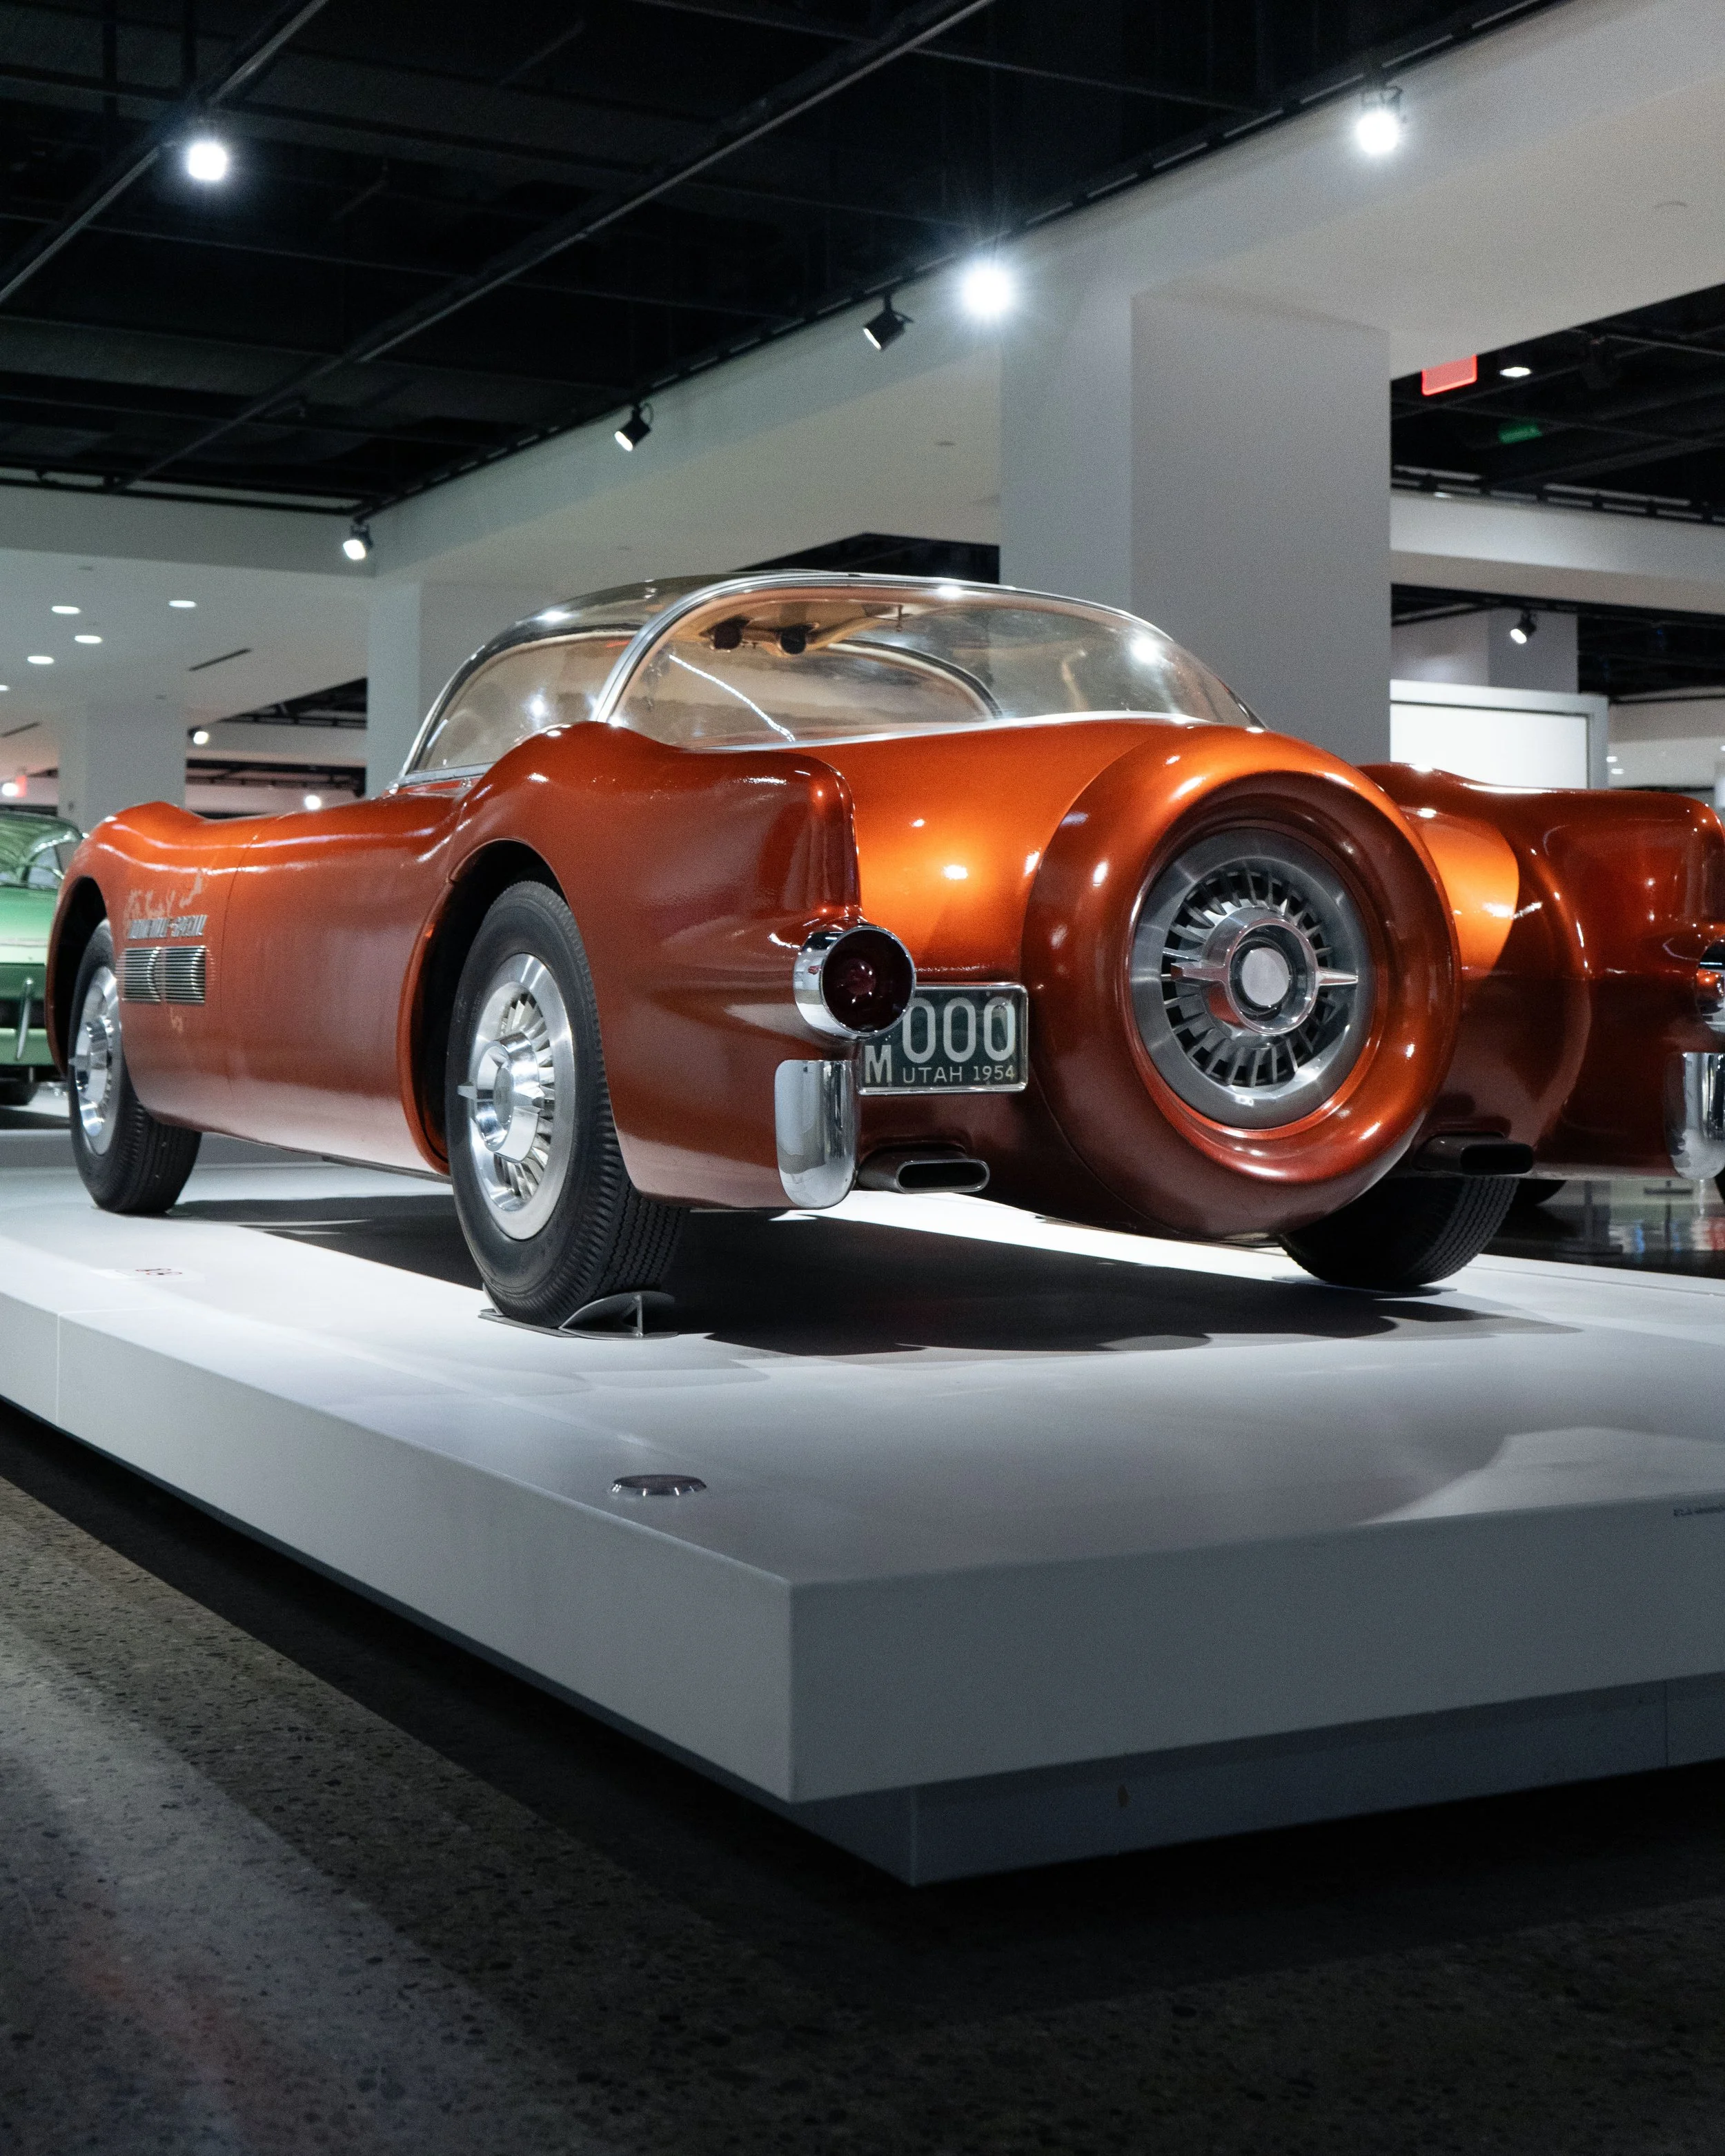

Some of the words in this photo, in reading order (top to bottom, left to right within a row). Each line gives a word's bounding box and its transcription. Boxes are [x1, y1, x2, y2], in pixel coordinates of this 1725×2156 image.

[902, 997, 1016, 1063] 000
[865, 1045, 891, 1084] M
[903, 1067, 963, 1083] UTAH
[974, 1065, 1015, 1081] 1954
